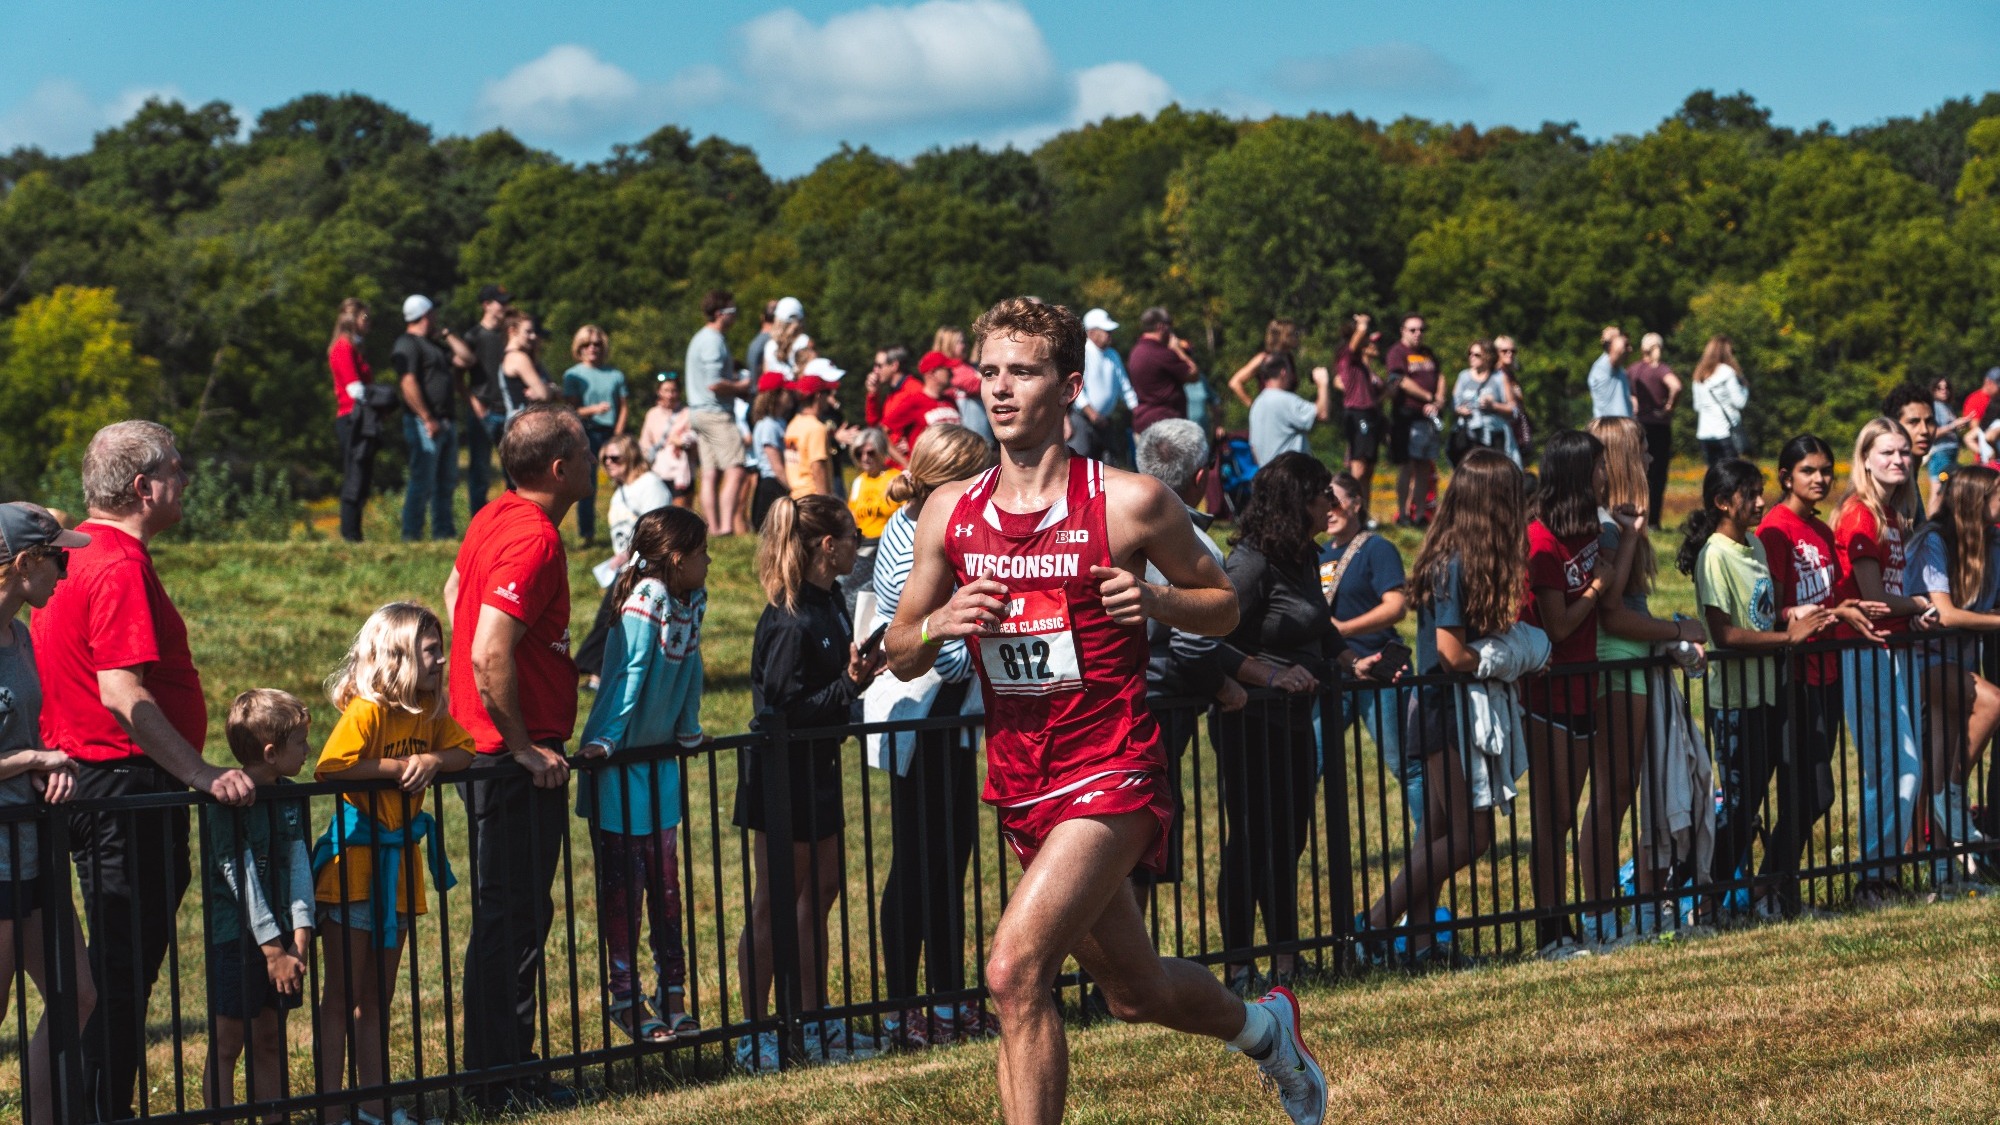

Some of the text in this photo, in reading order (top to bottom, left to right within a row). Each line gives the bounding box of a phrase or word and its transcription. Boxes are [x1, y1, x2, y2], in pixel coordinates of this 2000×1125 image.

[963, 552, 1080, 579] WISCONSIN
[979, 616, 1065, 634] ADGER CLASSIC
[998, 640, 1055, 681] 812
